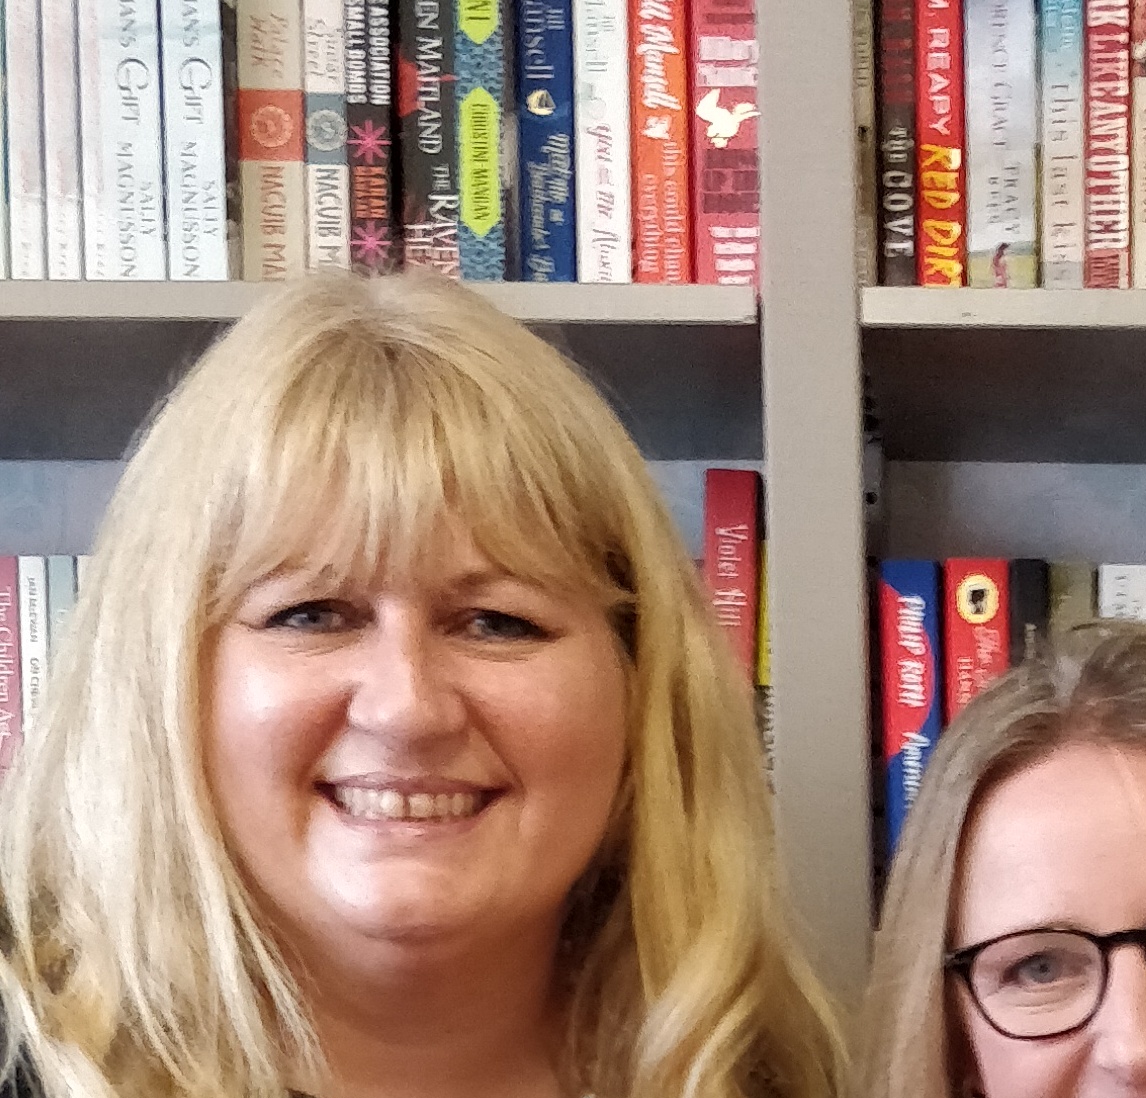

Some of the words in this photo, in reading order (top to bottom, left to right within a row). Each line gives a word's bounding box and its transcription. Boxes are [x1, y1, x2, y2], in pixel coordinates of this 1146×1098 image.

[369, 6, 391, 105] ASSOCIATION
[926, 28, 951, 137] REAPY
[1088, 32, 1129, 97] LIKE
[415, 36, 443, 154] MAITLAND
[1088, 100, 1129, 155] ANY
[117, 142, 136, 277] MAGNUSSON
[138, 181, 156, 236] SALLY
[180, 142, 200, 277] MAGNUSSON
[202, 181, 218, 237] SALLY
[919, 144, 962, 210] RED
[1085, 155, 1129, 250] OTHER
[882, 170, 914, 258] COVE
[714, 524, 749, 579] Violet
[0, 586, 13, 621] The
[896, 596, 927, 655] PHILIP
[0, 626, 14, 702] Children
[897, 659, 928, 707] ROTH
